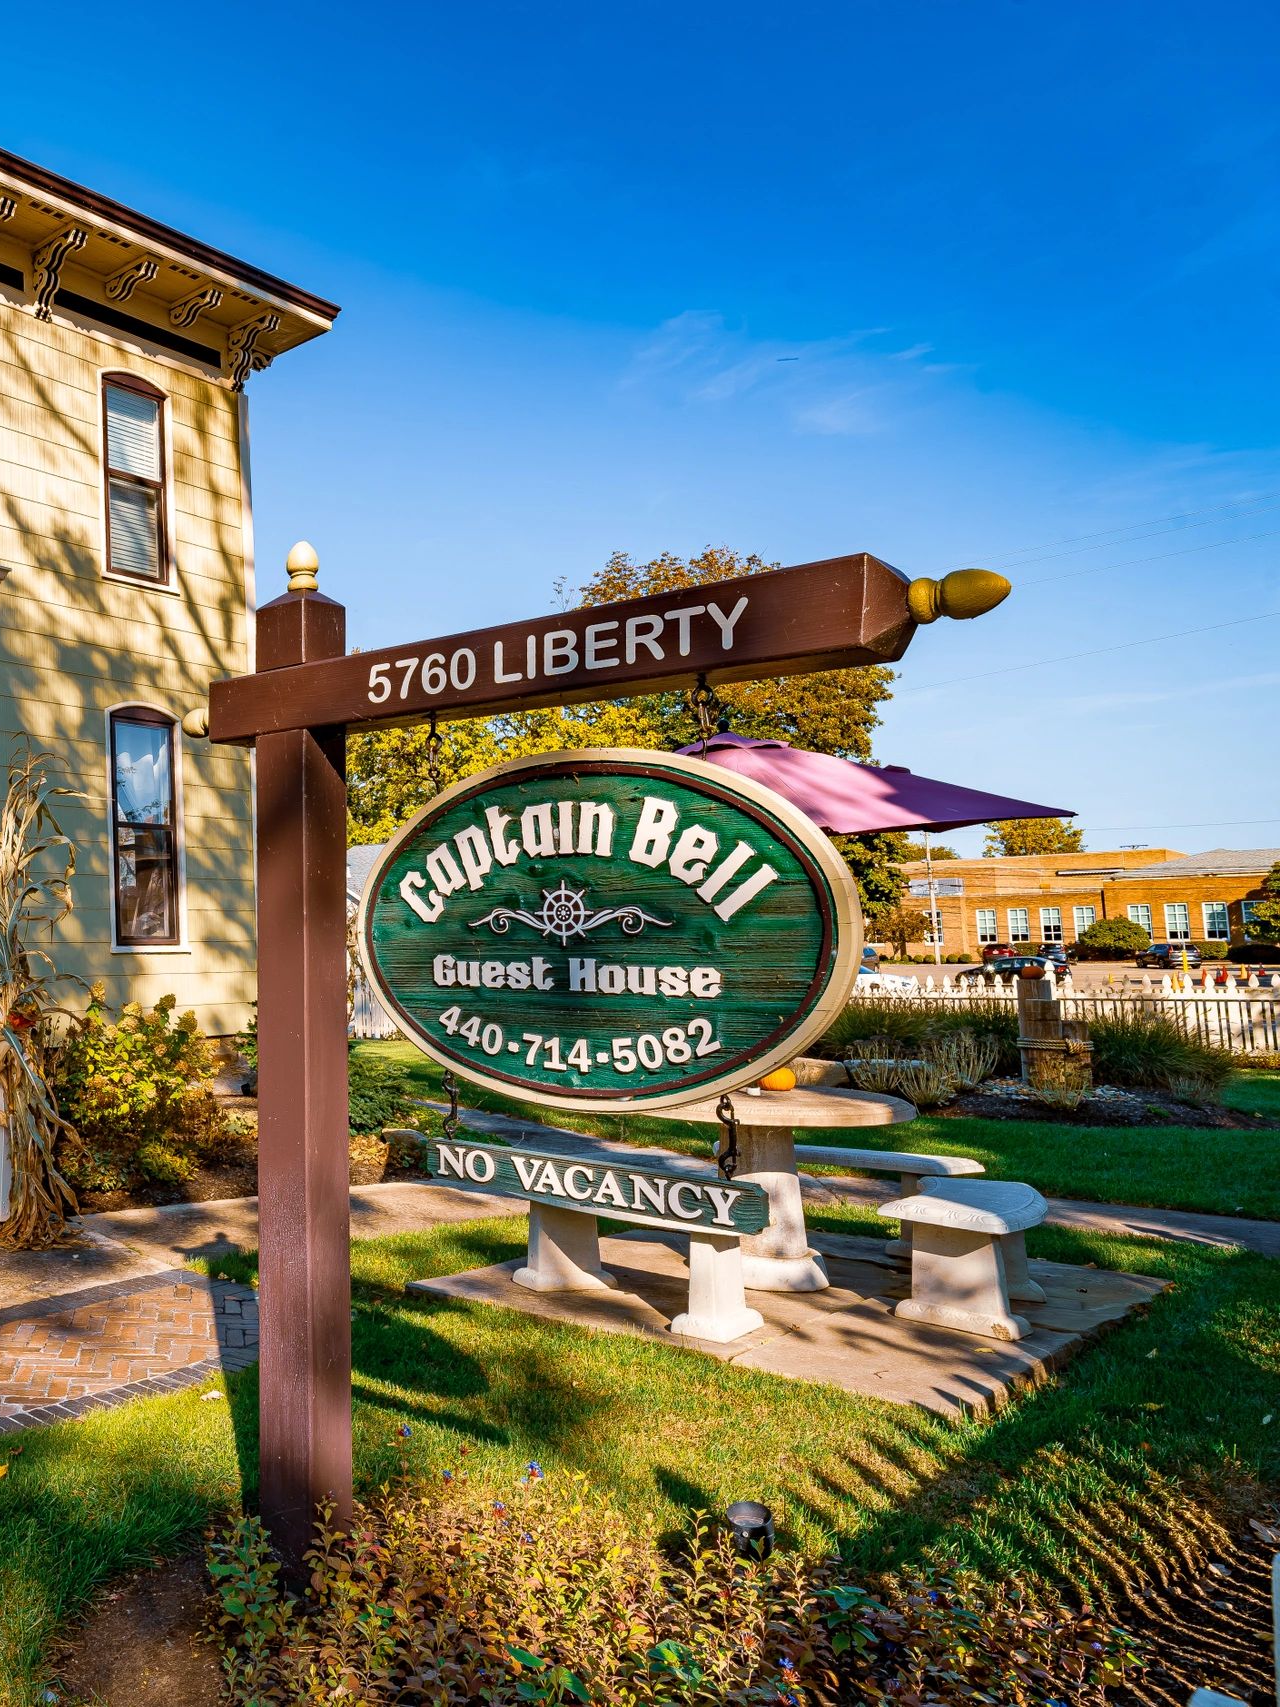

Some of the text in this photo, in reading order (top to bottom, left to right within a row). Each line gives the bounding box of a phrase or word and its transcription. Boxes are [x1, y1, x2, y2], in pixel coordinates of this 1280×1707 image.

[367, 597, 748, 704] 5760 LIBERTY
[399, 796, 778, 923] Captain Bell
[433, 954, 721, 998] Guest House
[438, 1005, 721, 1074] 440-714-5082
[436, 1144, 741, 1227] NO VACANCY
